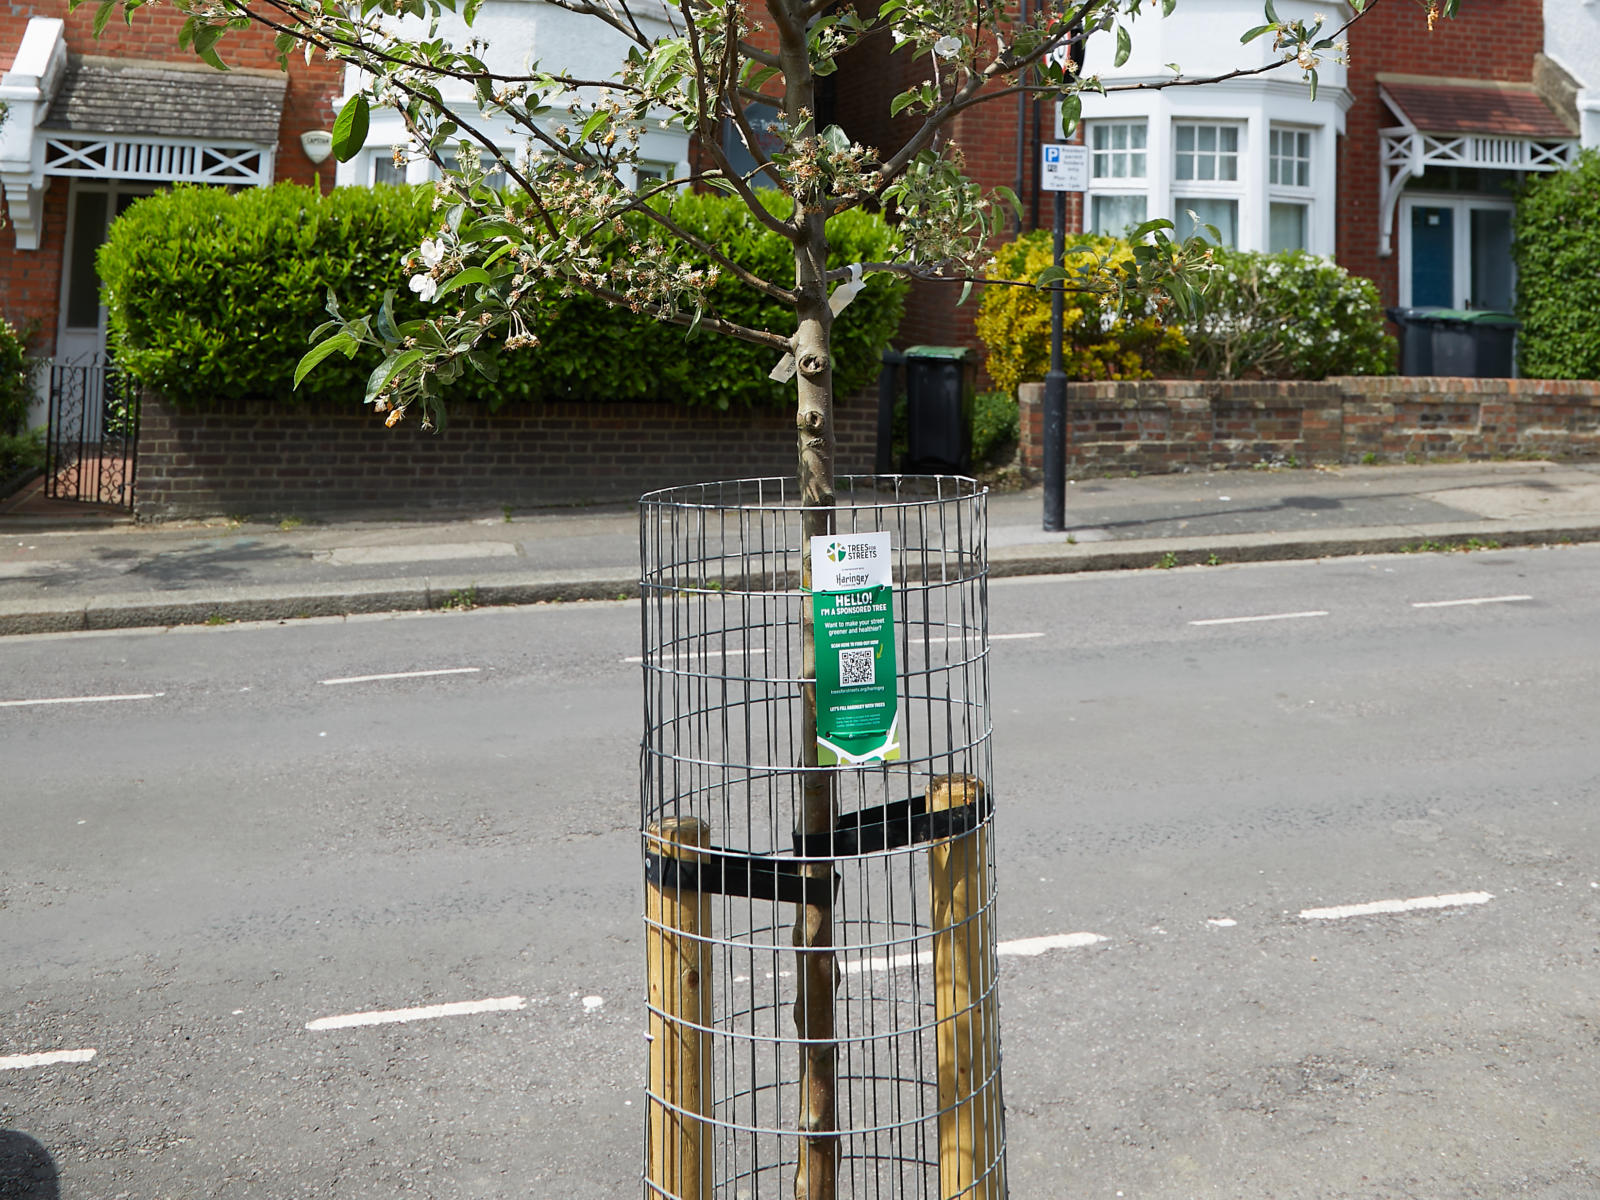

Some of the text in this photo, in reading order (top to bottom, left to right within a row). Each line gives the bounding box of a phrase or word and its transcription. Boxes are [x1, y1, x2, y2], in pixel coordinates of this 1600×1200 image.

[1048, 148, 1058, 162] P
[847, 543, 869, 552] TREES
[848, 550, 877, 560] STREETS
[836, 572, 869, 586] Haringey
[836, 592, 872, 607] HELLO!
[820, 603, 887, 616] I'M A SPONSORED TREE
[824, 621, 838, 629] Want
[859, 618, 870, 627] your
[870, 617, 885, 625] street
[828, 628, 848, 637] greener
[858, 625, 882, 633] healthier?
